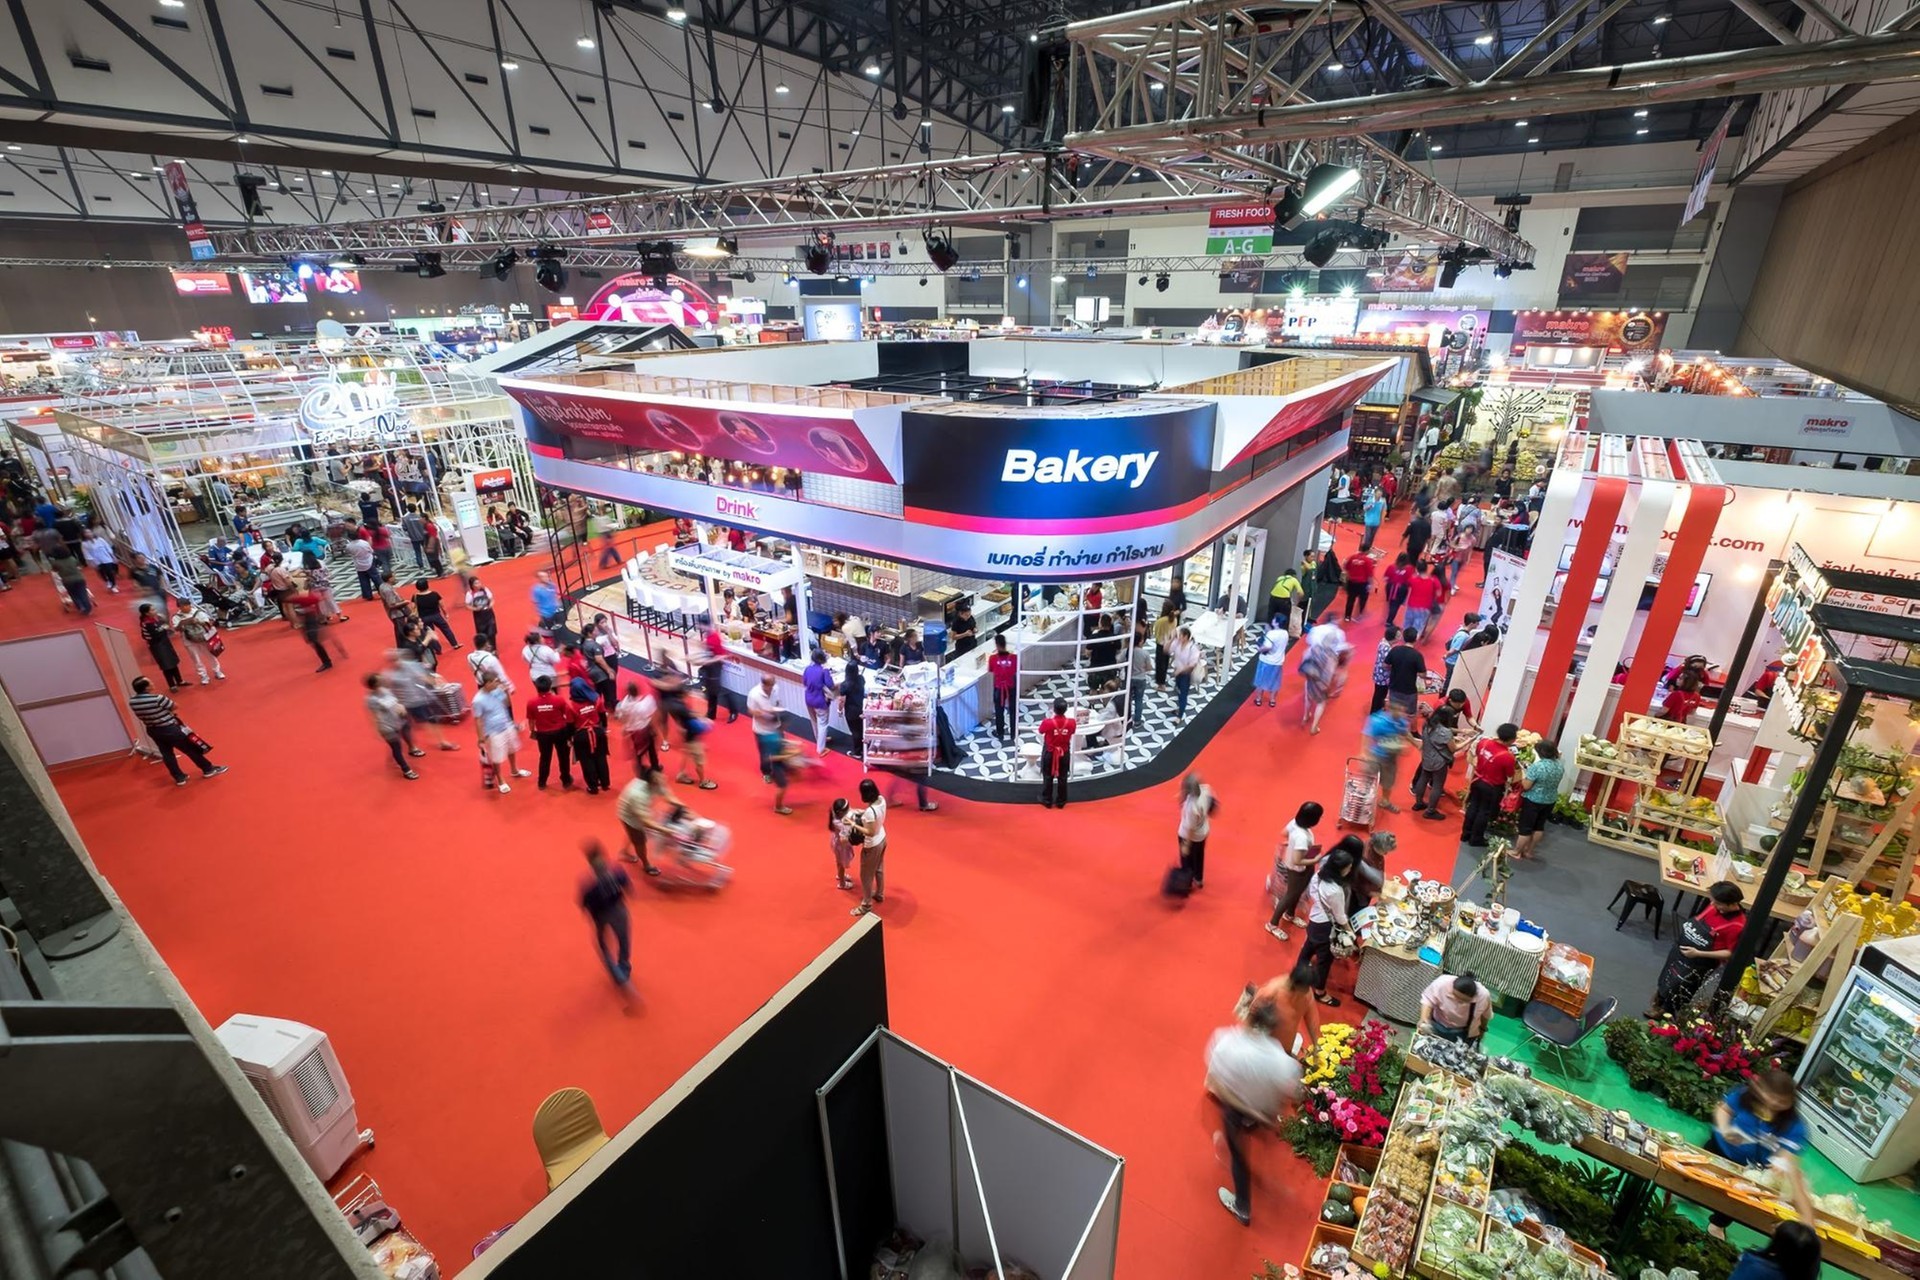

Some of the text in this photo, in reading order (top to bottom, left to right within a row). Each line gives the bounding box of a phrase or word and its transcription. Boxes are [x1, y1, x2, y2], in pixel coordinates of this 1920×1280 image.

[1215, 207, 1271, 219] FRESH FOOD
[1223, 238, 1254, 254] A-G
[1368, 302, 1397, 311] makro
[1288, 315, 1317, 327] PFP
[1545, 319, 1590, 331] makro
[201, 325, 232, 335] true
[524, 398, 612, 425] Inspiration
[1806, 417, 1848, 428] makro
[1001, 449, 1159, 488] Bakery
[716, 496, 756, 518] Drink
[987, 543, 1164, 567] เบเกอรี่ ทำง่าย กำไรงาม
[722, 570, 731, 579] by
[732, 570, 761, 585] makro
[1829, 588, 1853, 599] ick
[1860, 593, 1875, 602] &
